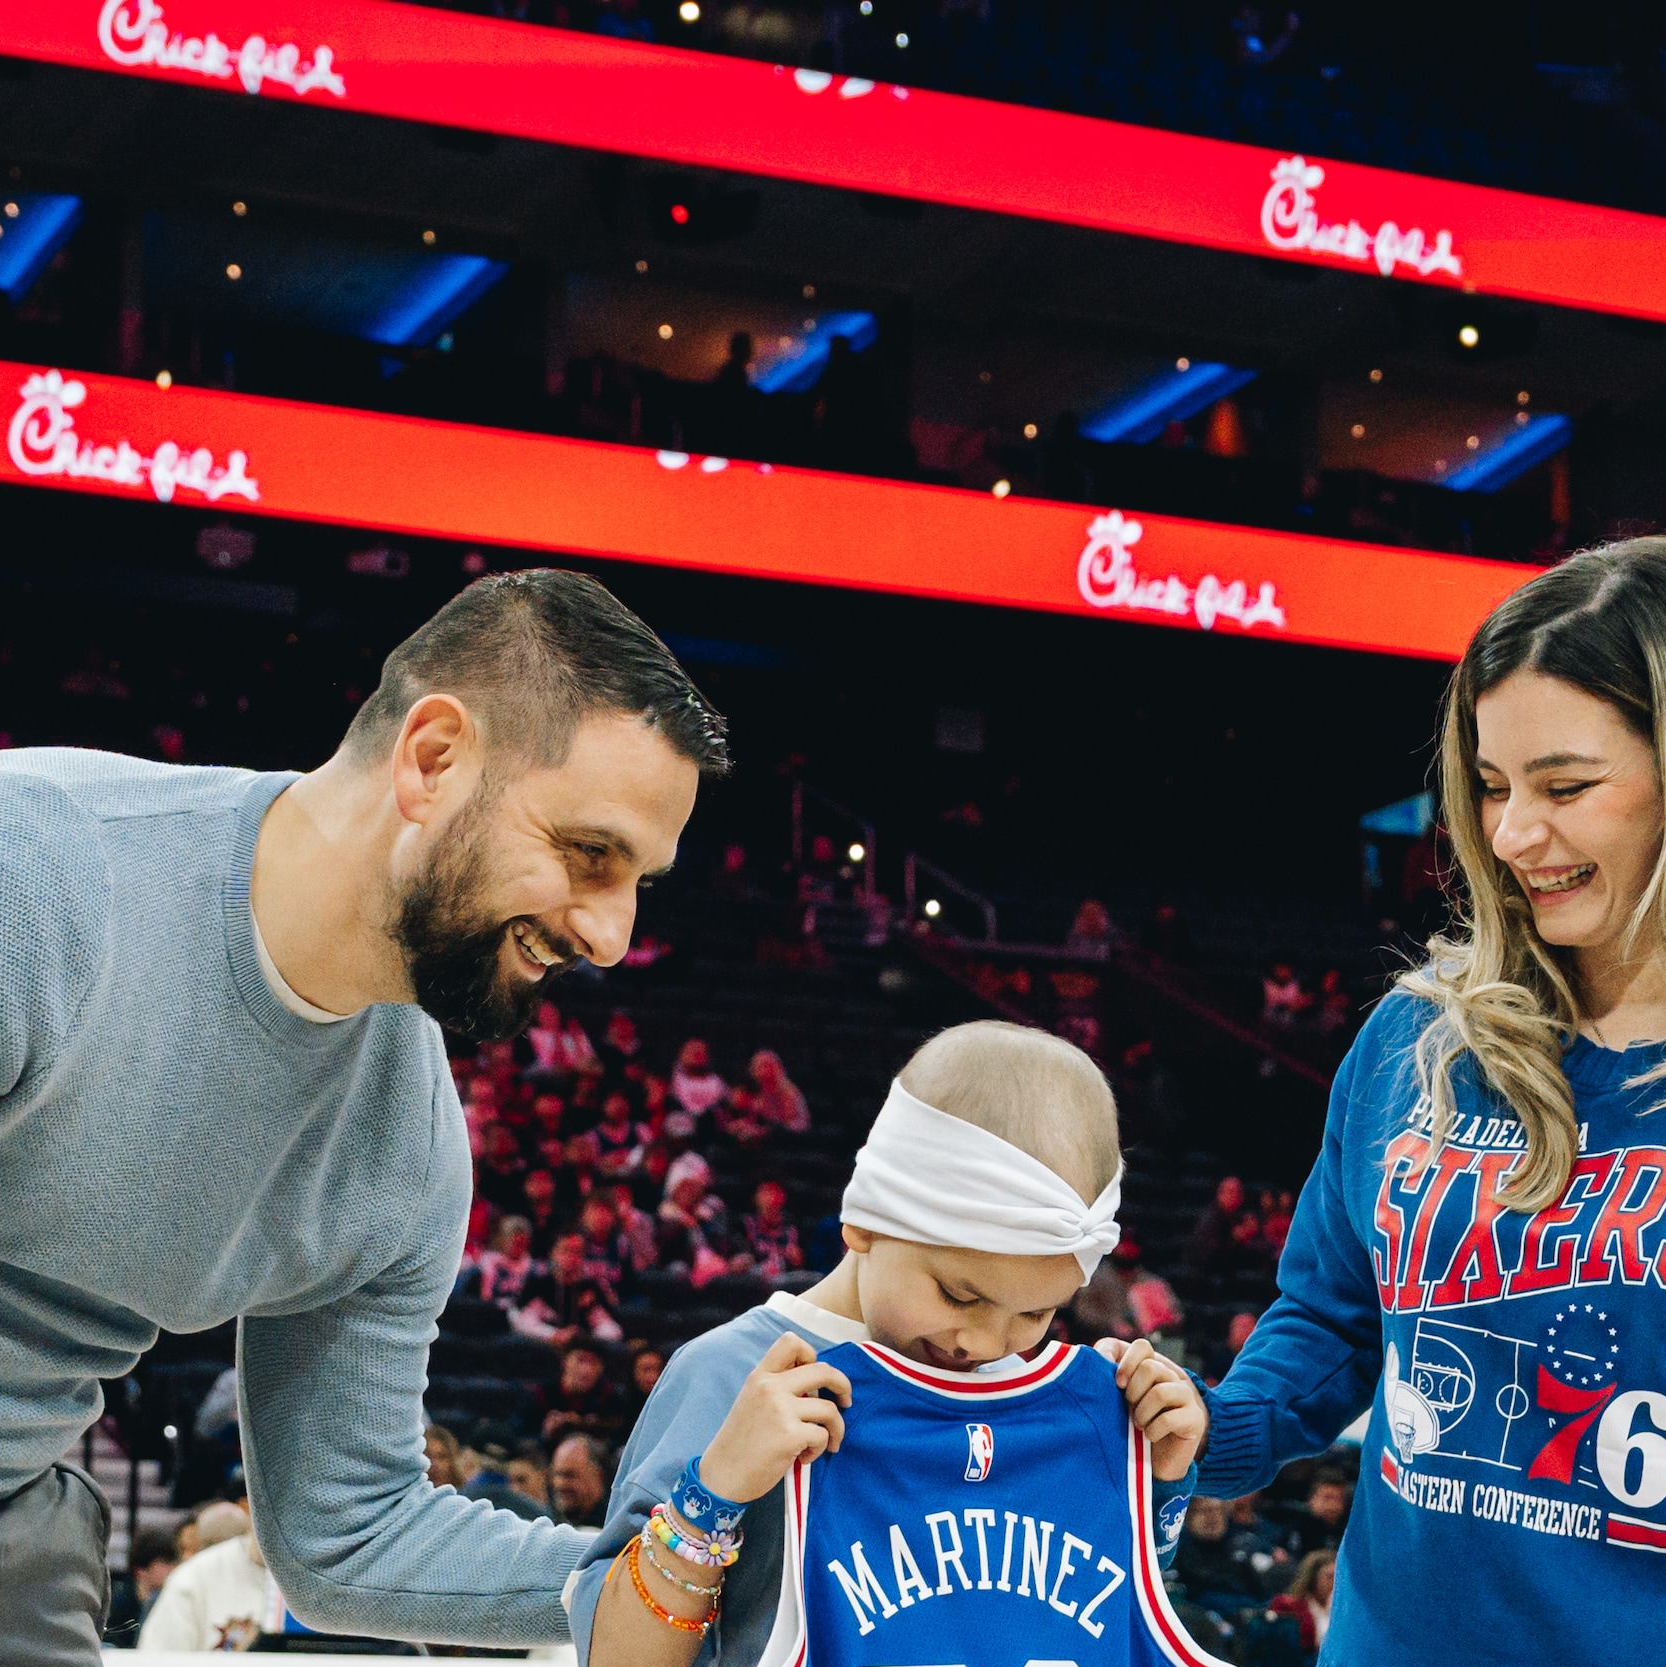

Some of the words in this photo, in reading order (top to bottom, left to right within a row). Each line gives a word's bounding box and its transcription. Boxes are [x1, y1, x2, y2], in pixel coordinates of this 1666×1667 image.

[1398, 1465, 1466, 1514] EASTERN
[1472, 1483, 1602, 1541] CONFERENCE
[827, 1508, 1127, 1639] MARTINEZ
